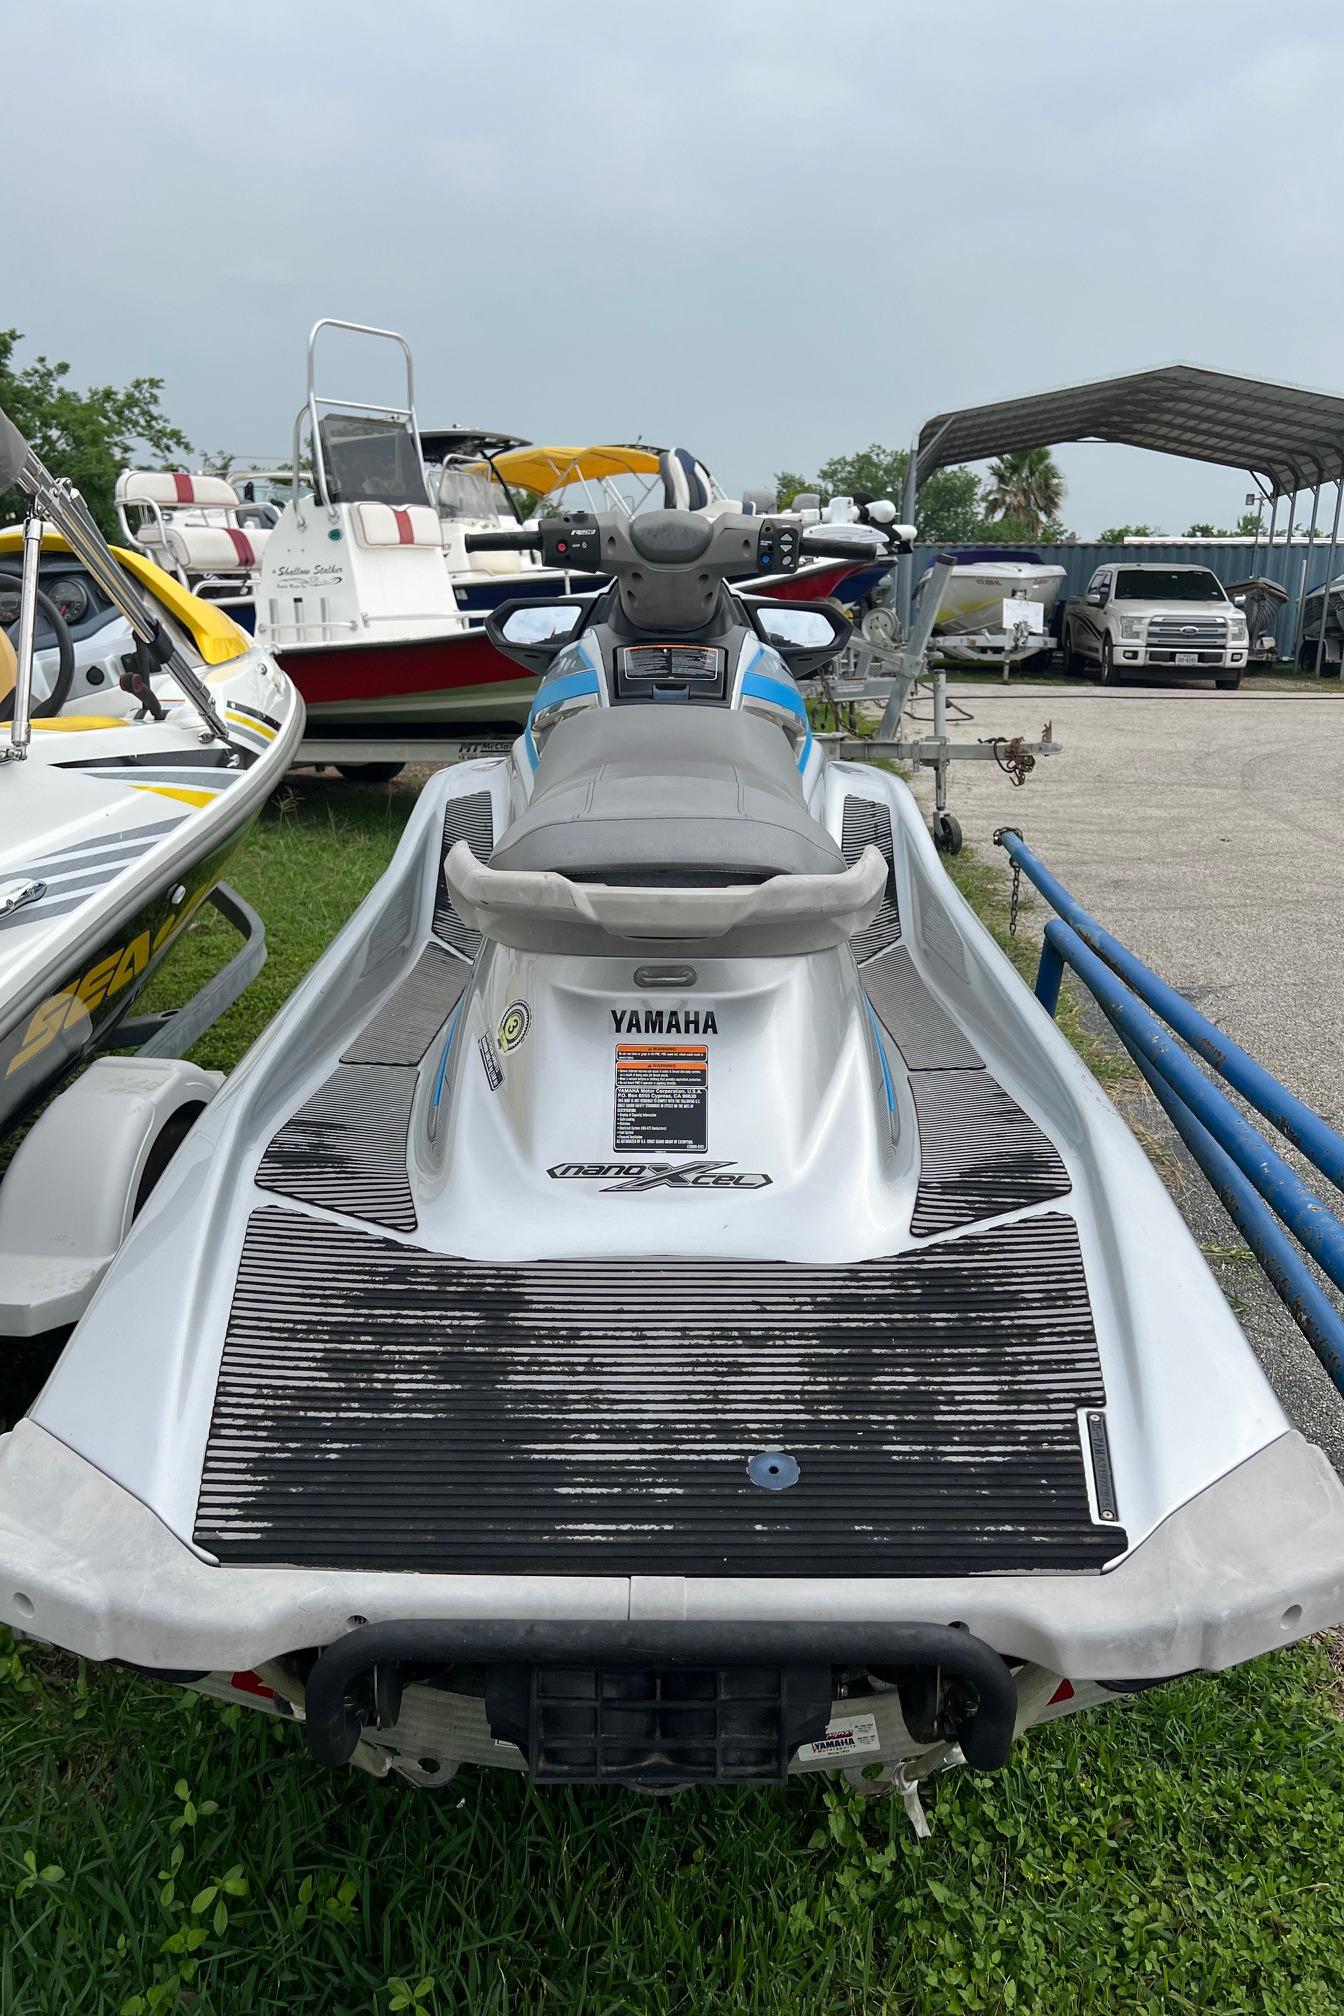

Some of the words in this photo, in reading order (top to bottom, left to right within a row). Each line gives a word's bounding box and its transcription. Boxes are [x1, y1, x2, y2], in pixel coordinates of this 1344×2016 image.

[278, 566, 311, 576] Shallow
[313, 564, 343, 575] Stalker
[610, 1009, 718, 1034] YAMAHA
[814, 1738, 855, 1750] YAMAHA
